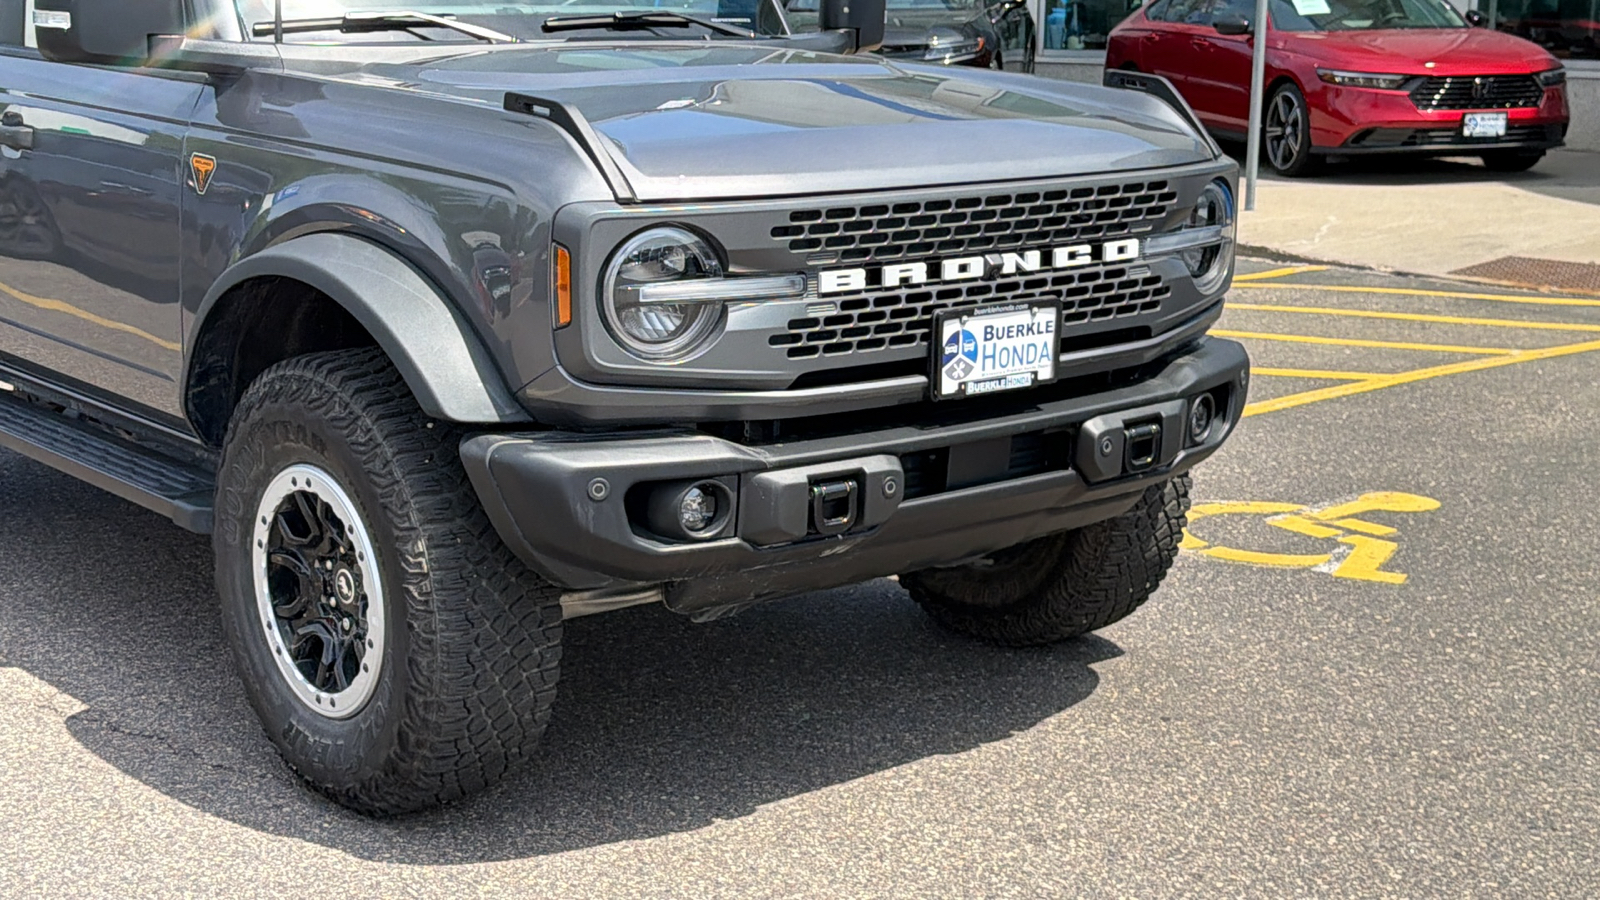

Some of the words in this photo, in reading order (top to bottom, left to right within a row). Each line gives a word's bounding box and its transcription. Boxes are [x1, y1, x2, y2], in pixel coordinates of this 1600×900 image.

[818, 238, 1140, 293] BRONCO
[983, 320, 1054, 341] BUERKLE
[981, 341, 1051, 372] HONDA
[967, 380, 1006, 393] BUERKLE
[1007, 376, 1030, 388] HONDA
